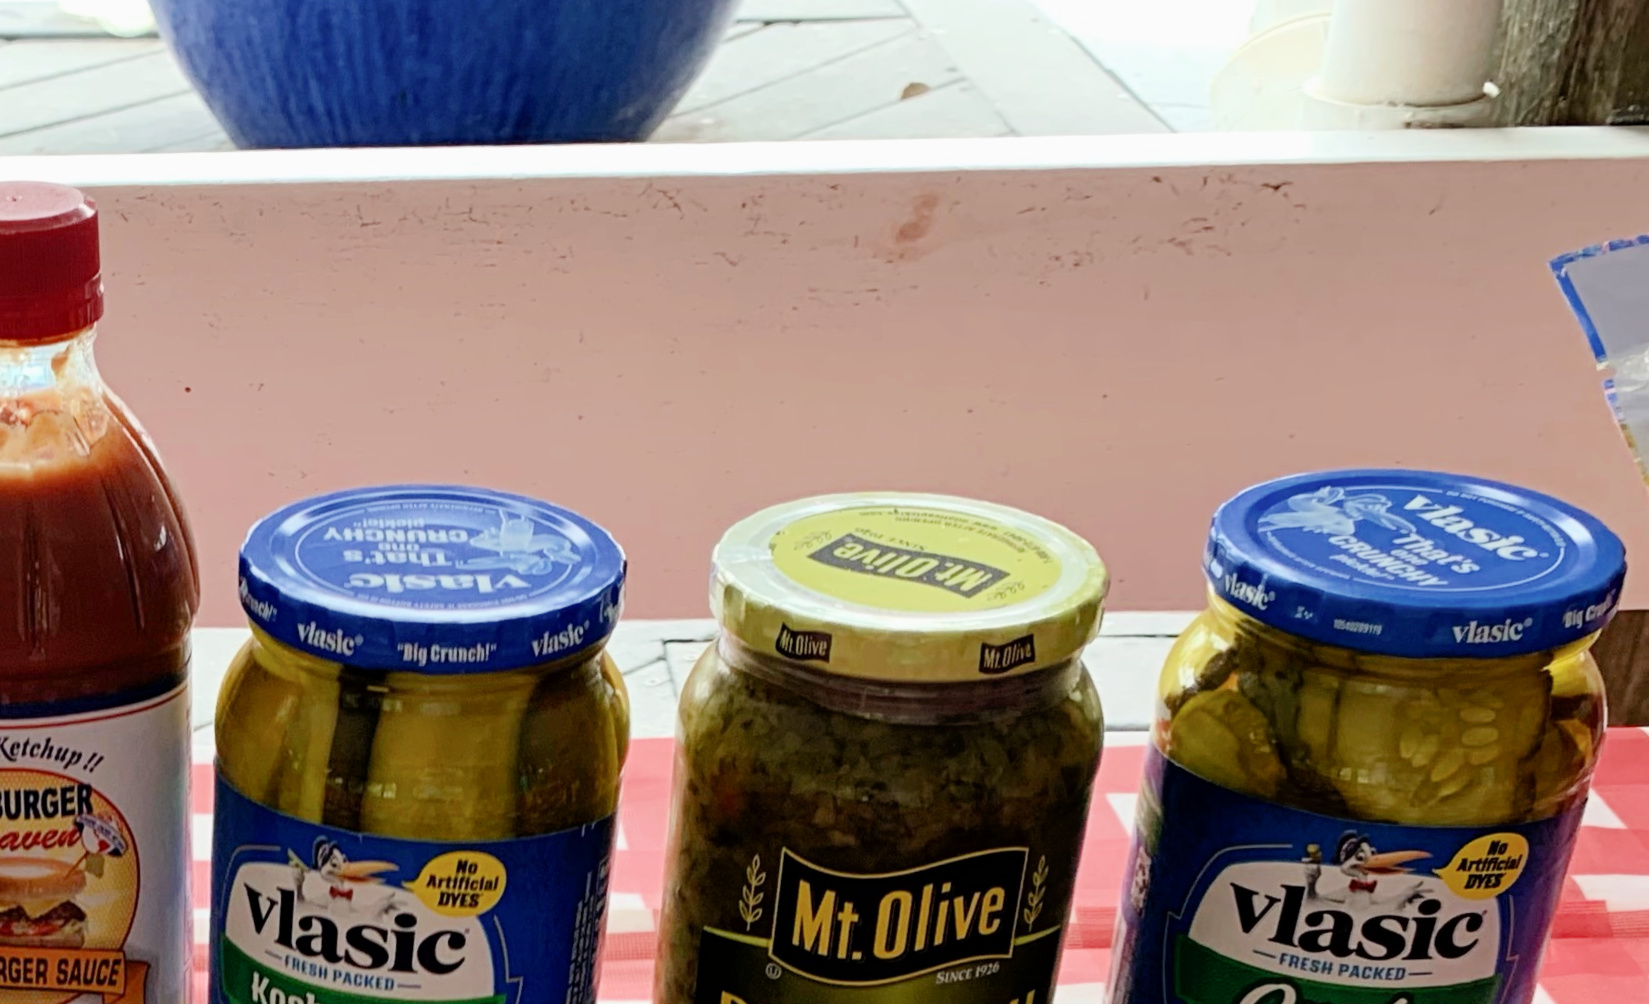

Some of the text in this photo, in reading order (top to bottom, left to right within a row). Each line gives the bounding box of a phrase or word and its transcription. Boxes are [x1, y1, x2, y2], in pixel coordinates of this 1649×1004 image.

[324, 527, 470, 544] CRUNCHY
[1403, 493, 1539, 562] vlasic
[378, 542, 421, 553] one
[1390, 548, 1430, 566] one
[1328, 535, 1449, 588] CRUNCHY
[348, 573, 532, 594] vlasic
[1223, 573, 1270, 611] vlasic
[296, 621, 355, 657] vlasic
[531, 623, 585, 659] vlasic
[1452, 619, 1525, 646] vlasic
[430, 643, 498, 664] Crunch!"
[85, 755, 106, 773] !!
[1488, 839, 1508, 856] No
[455, 859, 478, 876] No
[1455, 855, 1521, 873] Artificial
[425, 873, 500, 892] Artificial
[1464, 872, 1504, 890] DYES
[437, 892, 482, 910] DYES
[243, 882, 468, 975] vlasic
[1229, 882, 1484, 962] vlasic
[56, 957, 122, 988] SAUCE
[284, 954, 395, 992] FRESH PACKED
[936, 961, 1001, 985] SINCE 1926
[1277, 953, 1406, 981] FRESH PACKED
